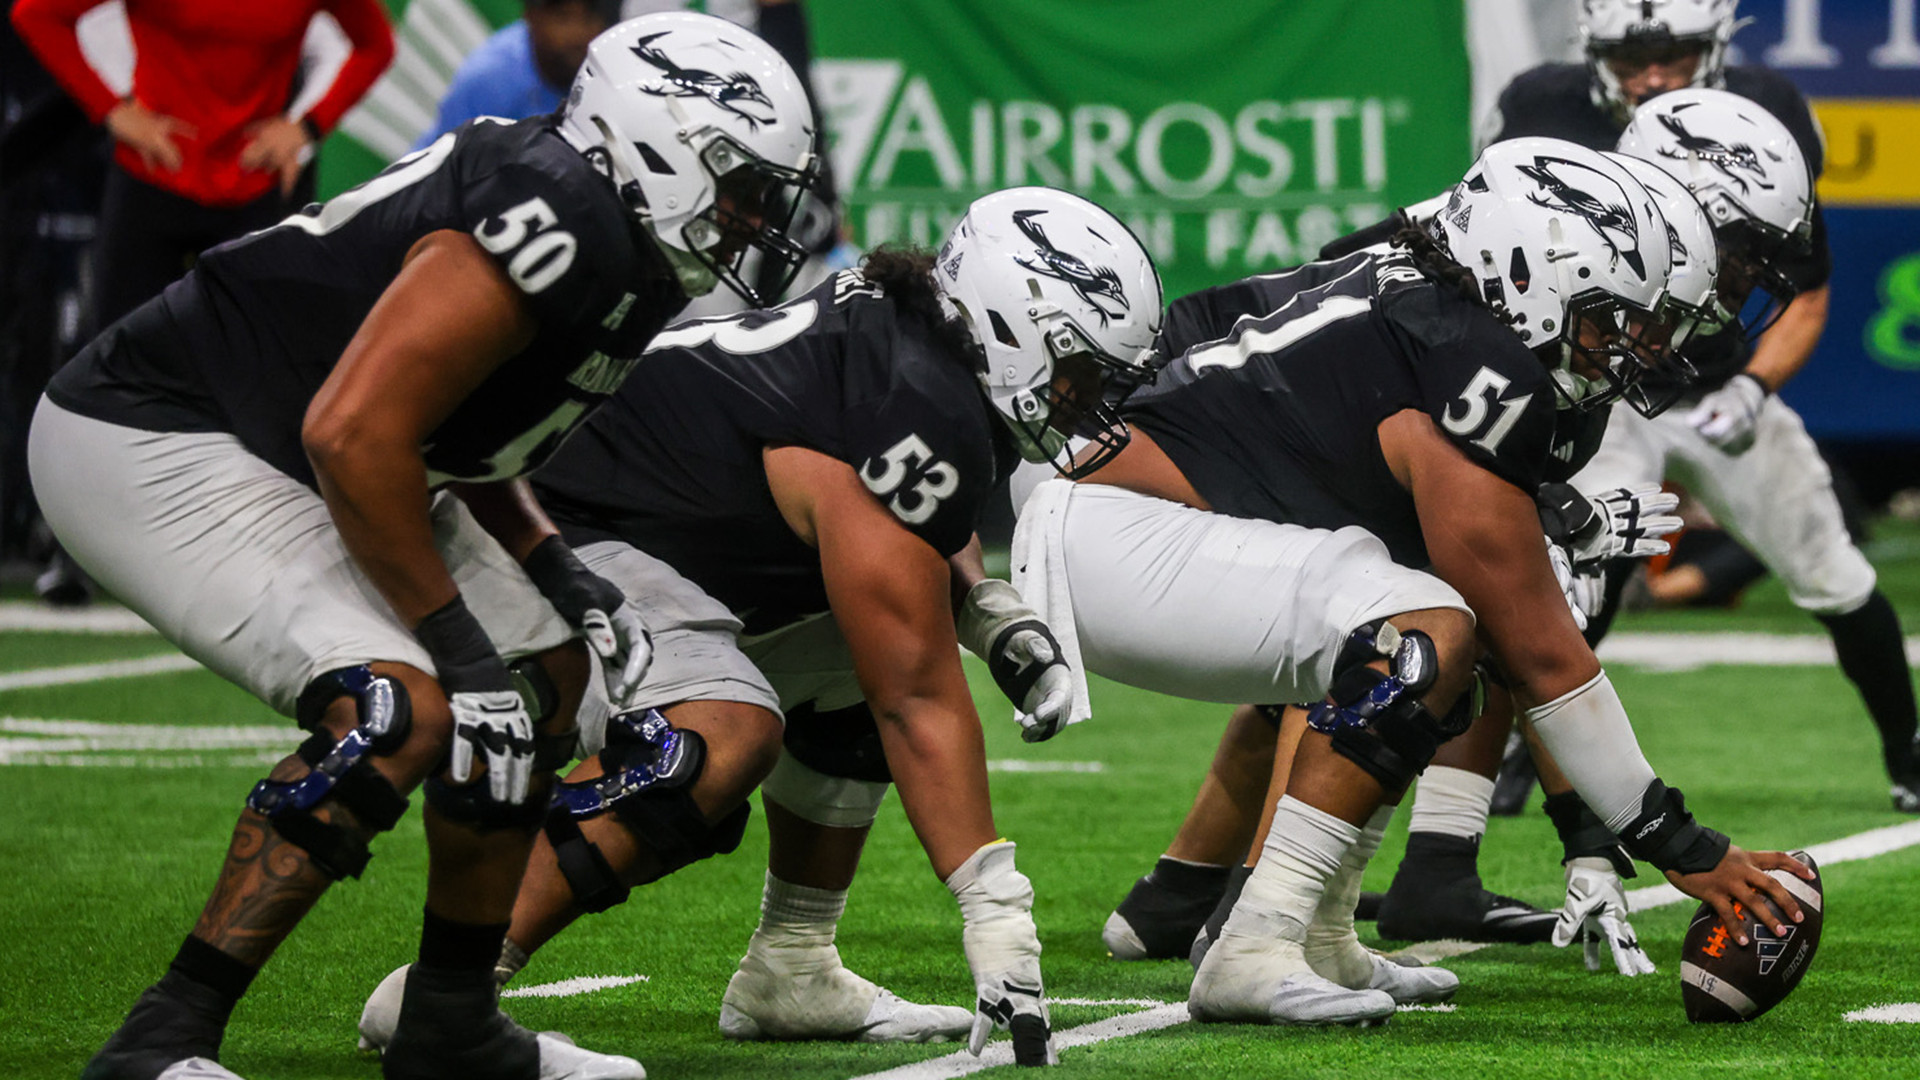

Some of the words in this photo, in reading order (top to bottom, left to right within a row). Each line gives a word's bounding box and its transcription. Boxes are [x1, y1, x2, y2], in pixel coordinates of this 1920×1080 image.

[868, 73, 1386, 200] AIRROSTI
[473, 197, 577, 293] 50
[1441, 366, 1533, 456] 51
[859, 433, 959, 525] 53
